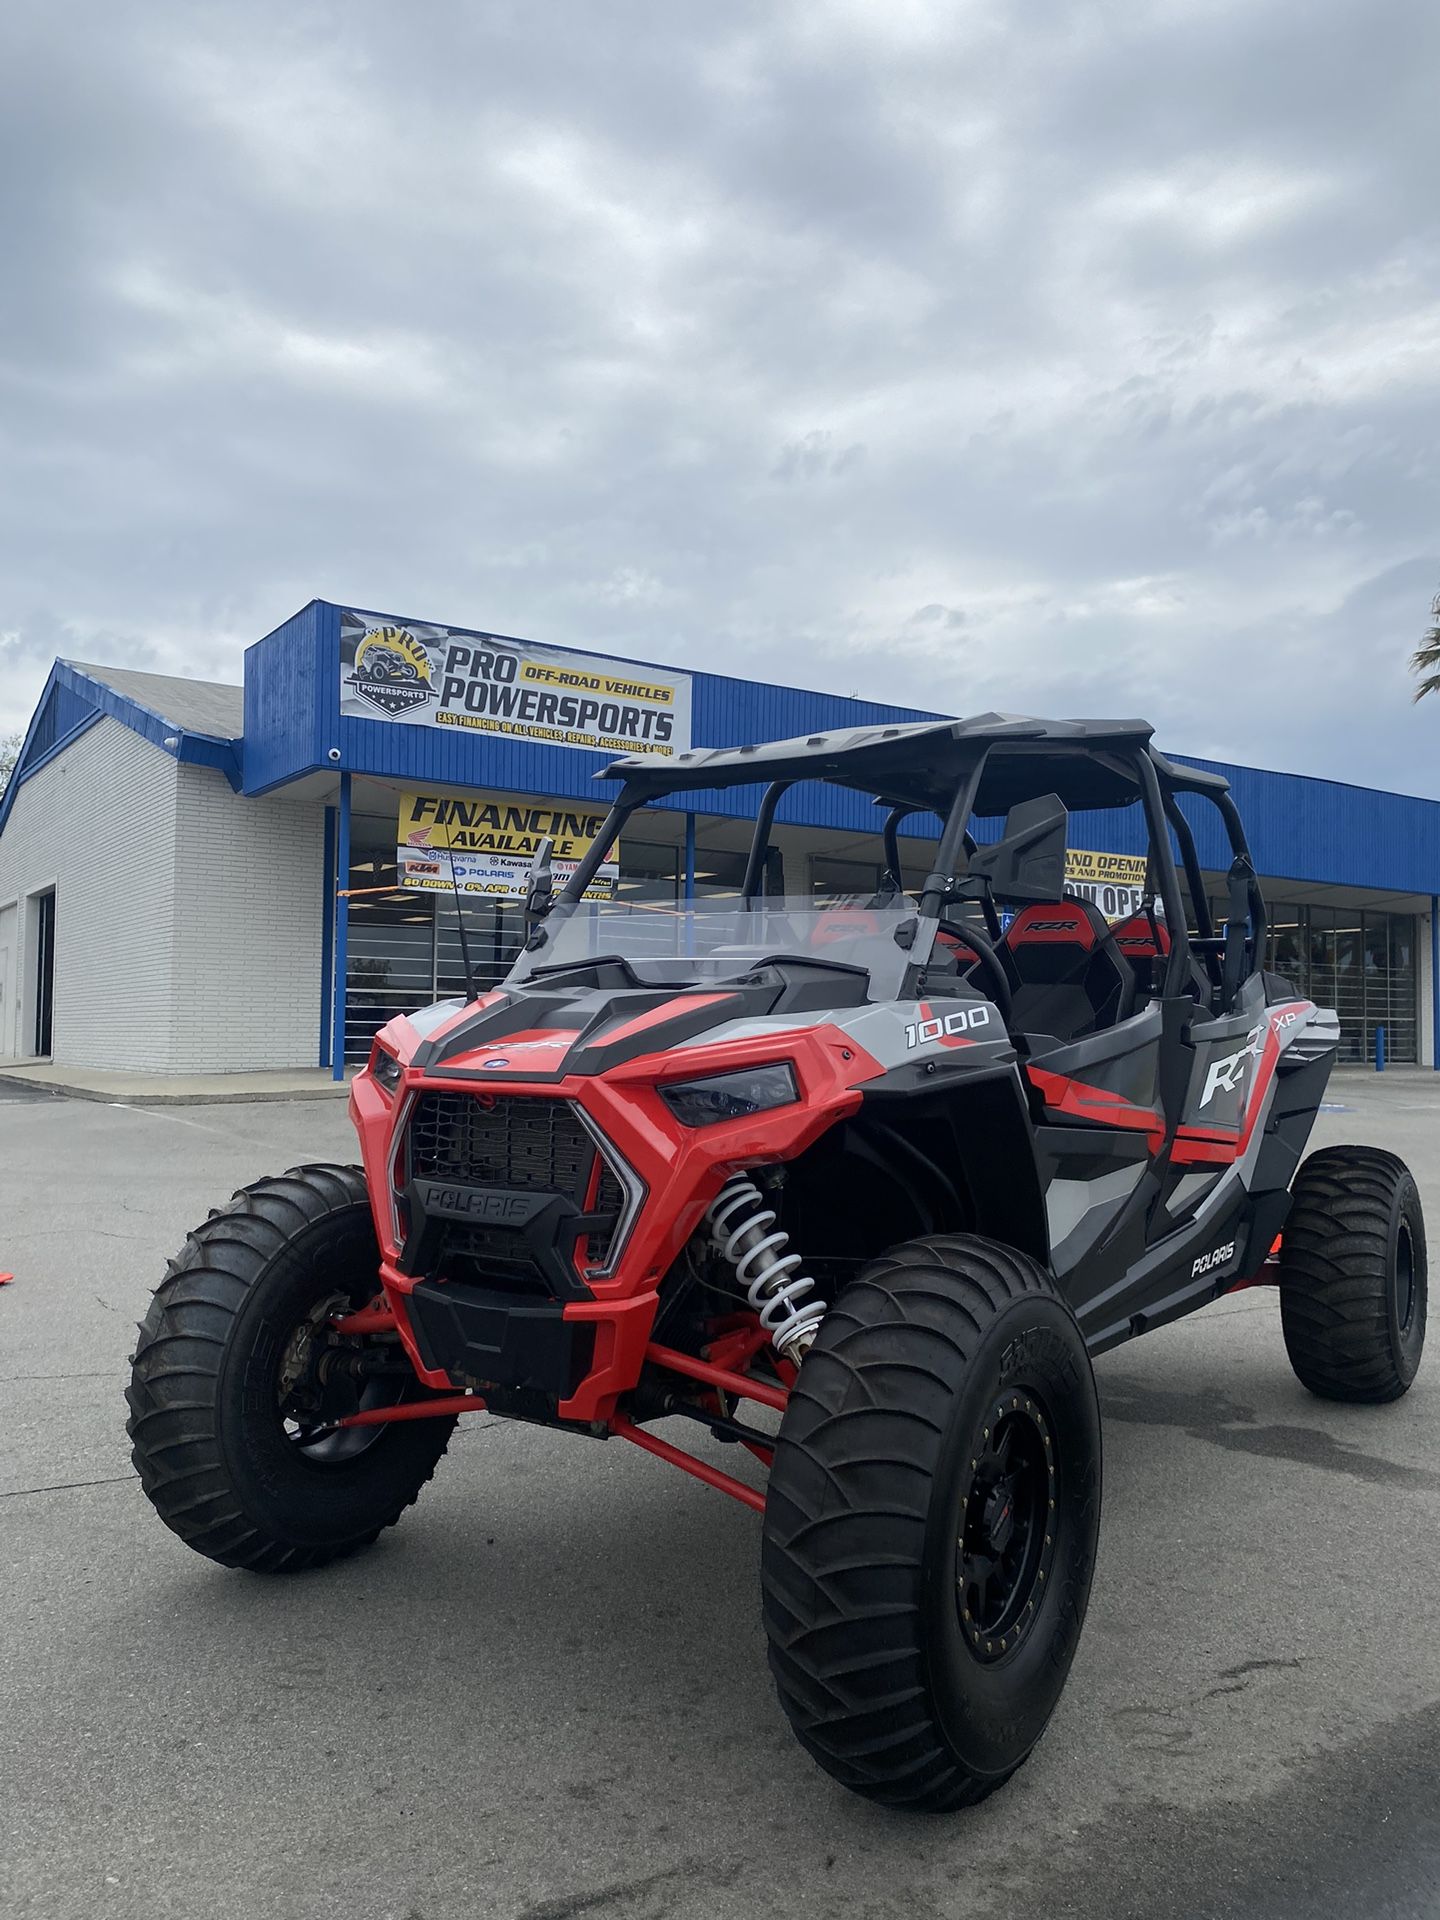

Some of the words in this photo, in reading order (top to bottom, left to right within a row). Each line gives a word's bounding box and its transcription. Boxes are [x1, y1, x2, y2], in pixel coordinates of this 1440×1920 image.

[383, 626, 427, 661] PRO
[445, 645, 518, 683] PRO
[361, 684, 424, 698] POWERSPORTS
[525, 667, 600, 689] OFF-ROAD
[605, 681, 671, 701] VEHICLES
[440, 676, 674, 741] POWERSPORTS
[436, 711, 456, 725] EASY
[458, 714, 500, 731] FINANCING
[500, 721, 512, 733] ON
[512, 723, 527, 735] ALL
[599, 736, 645, 752] ACCESSORIES
[451, 831, 573, 855] AVAILALE
[408, 862, 438, 873] KTM
[469, 868, 515, 879] POLARIS
[500, 859, 533, 868] Kawasa
[1077, 869, 1096, 877] AND
[1097, 857, 1147, 873] OPENIN
[420, 879, 455, 890] DOWN
[465, 882, 483, 892] 0%
[484, 884, 509, 894] APR
[1103, 886, 1145, 915] OPE
[905, 1006, 989, 1049] 1000
[1273, 1012, 1296, 1031] XP
[426, 1188, 530, 1217] POLARIS
[1191, 1241, 1235, 1278] POLARIS
